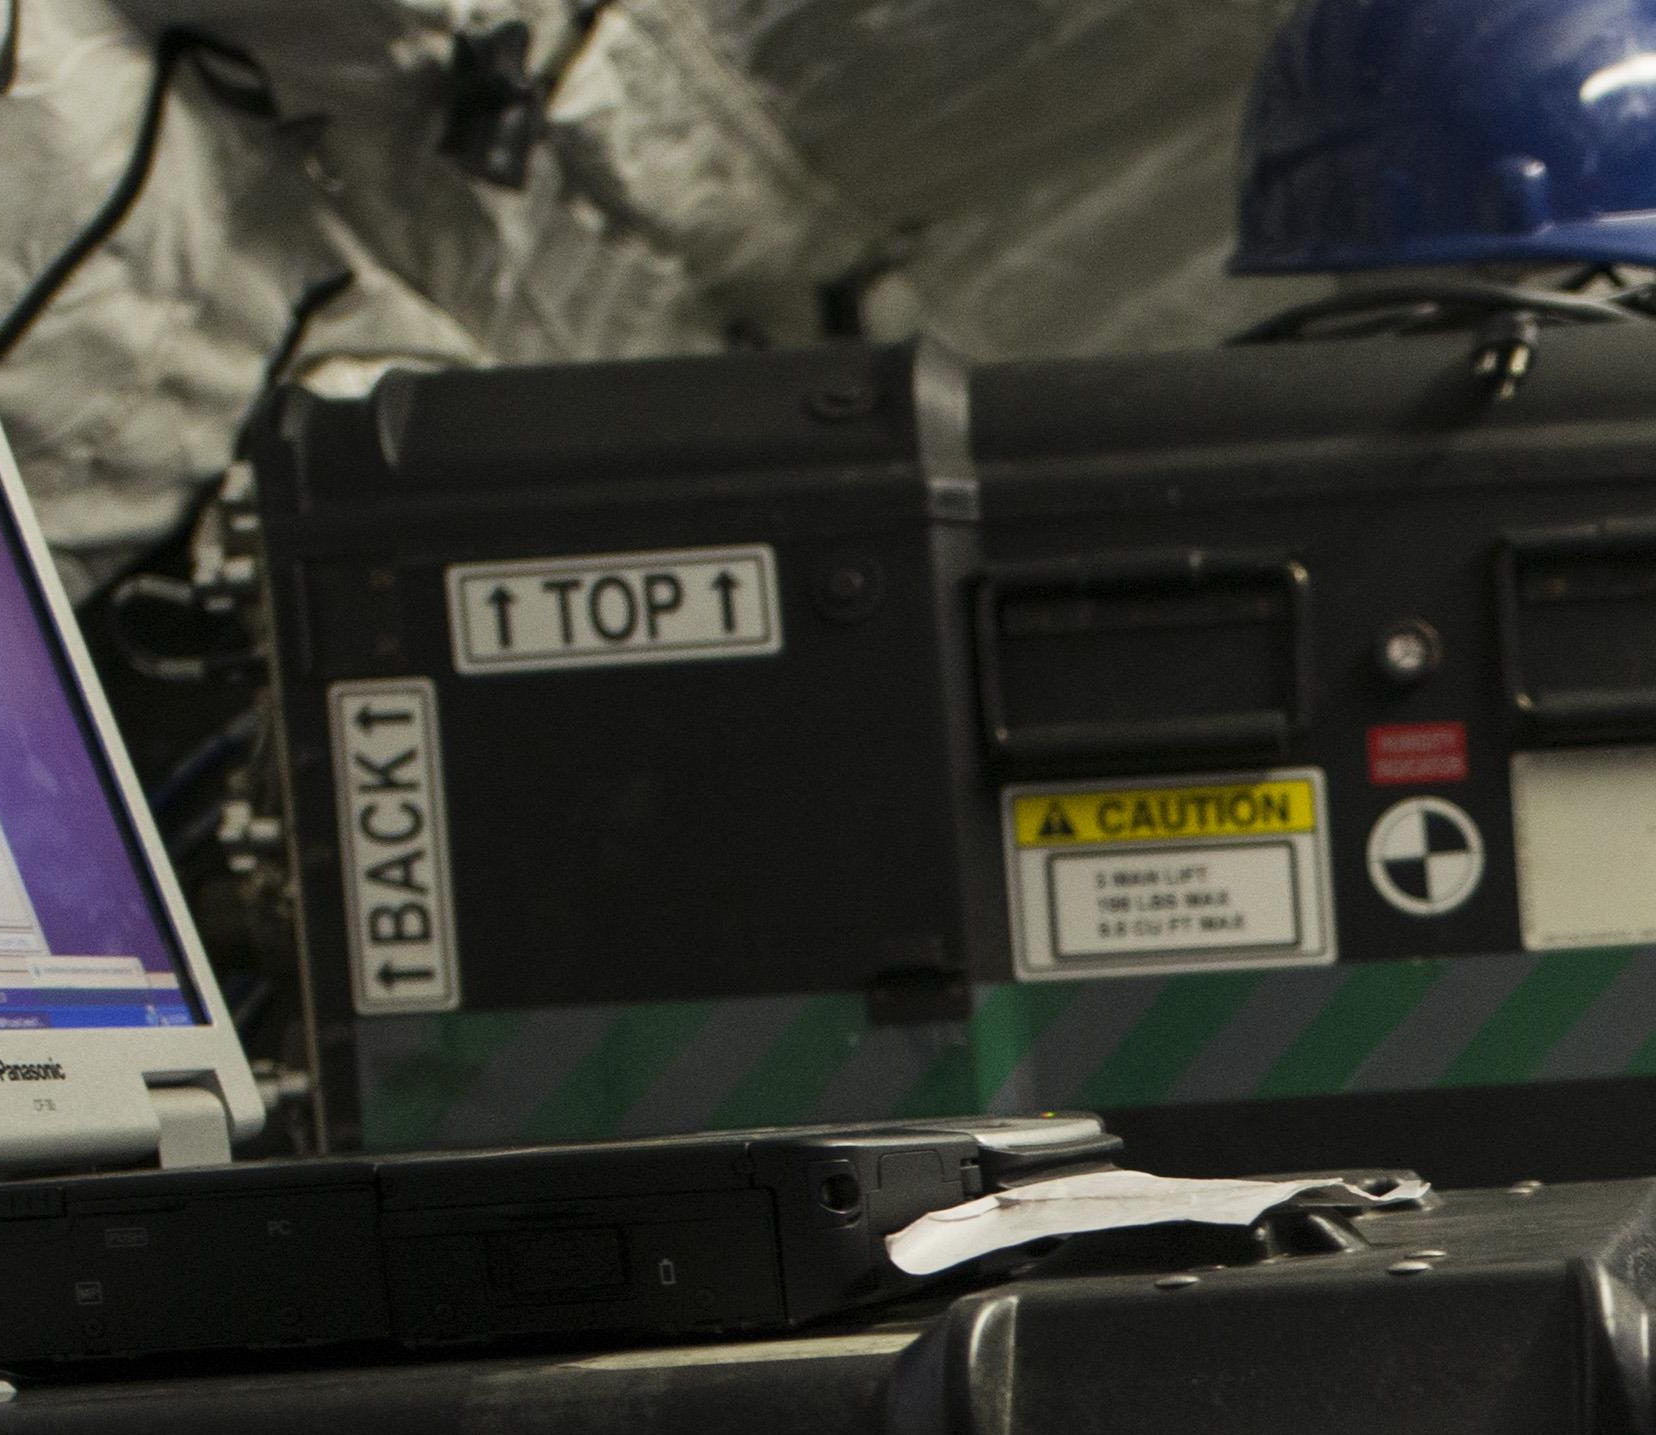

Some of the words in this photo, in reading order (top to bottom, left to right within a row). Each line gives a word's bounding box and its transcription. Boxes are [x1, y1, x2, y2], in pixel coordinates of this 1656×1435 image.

[543, 574, 684, 643] TOP
[1097, 791, 1291, 835] CAUTION
[358, 748, 432, 944] BACK
[268, 1220, 291, 1236] PC
